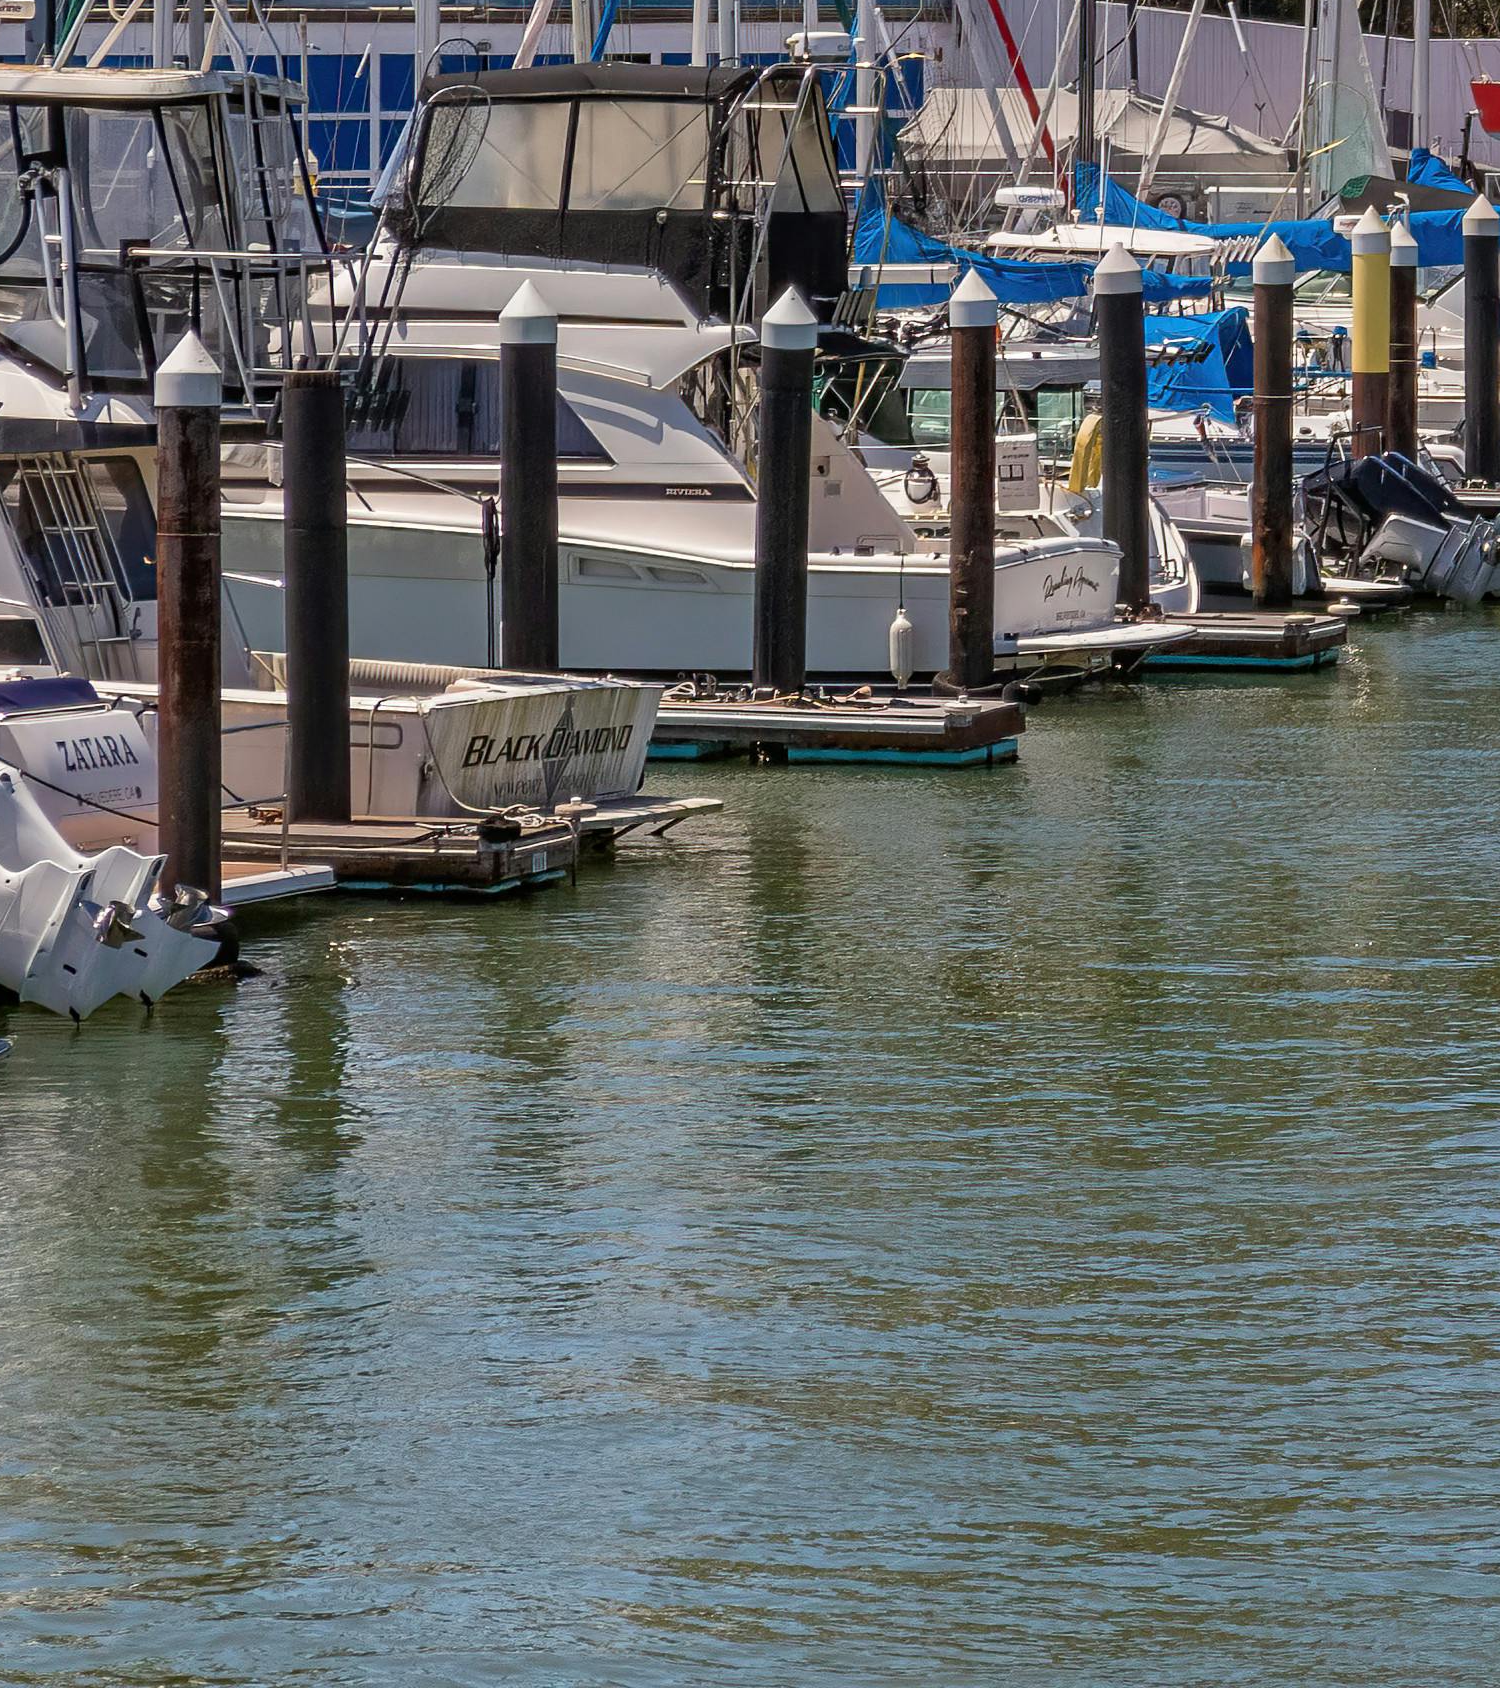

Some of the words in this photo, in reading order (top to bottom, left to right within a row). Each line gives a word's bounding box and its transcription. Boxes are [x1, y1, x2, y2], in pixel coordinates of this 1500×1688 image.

[665, 488, 712, 496] RIVIERA
[55, 733, 139, 772] ZATARA
[462, 733, 546, 768] BLACK
[542, 724, 633, 759] DIAMOND
